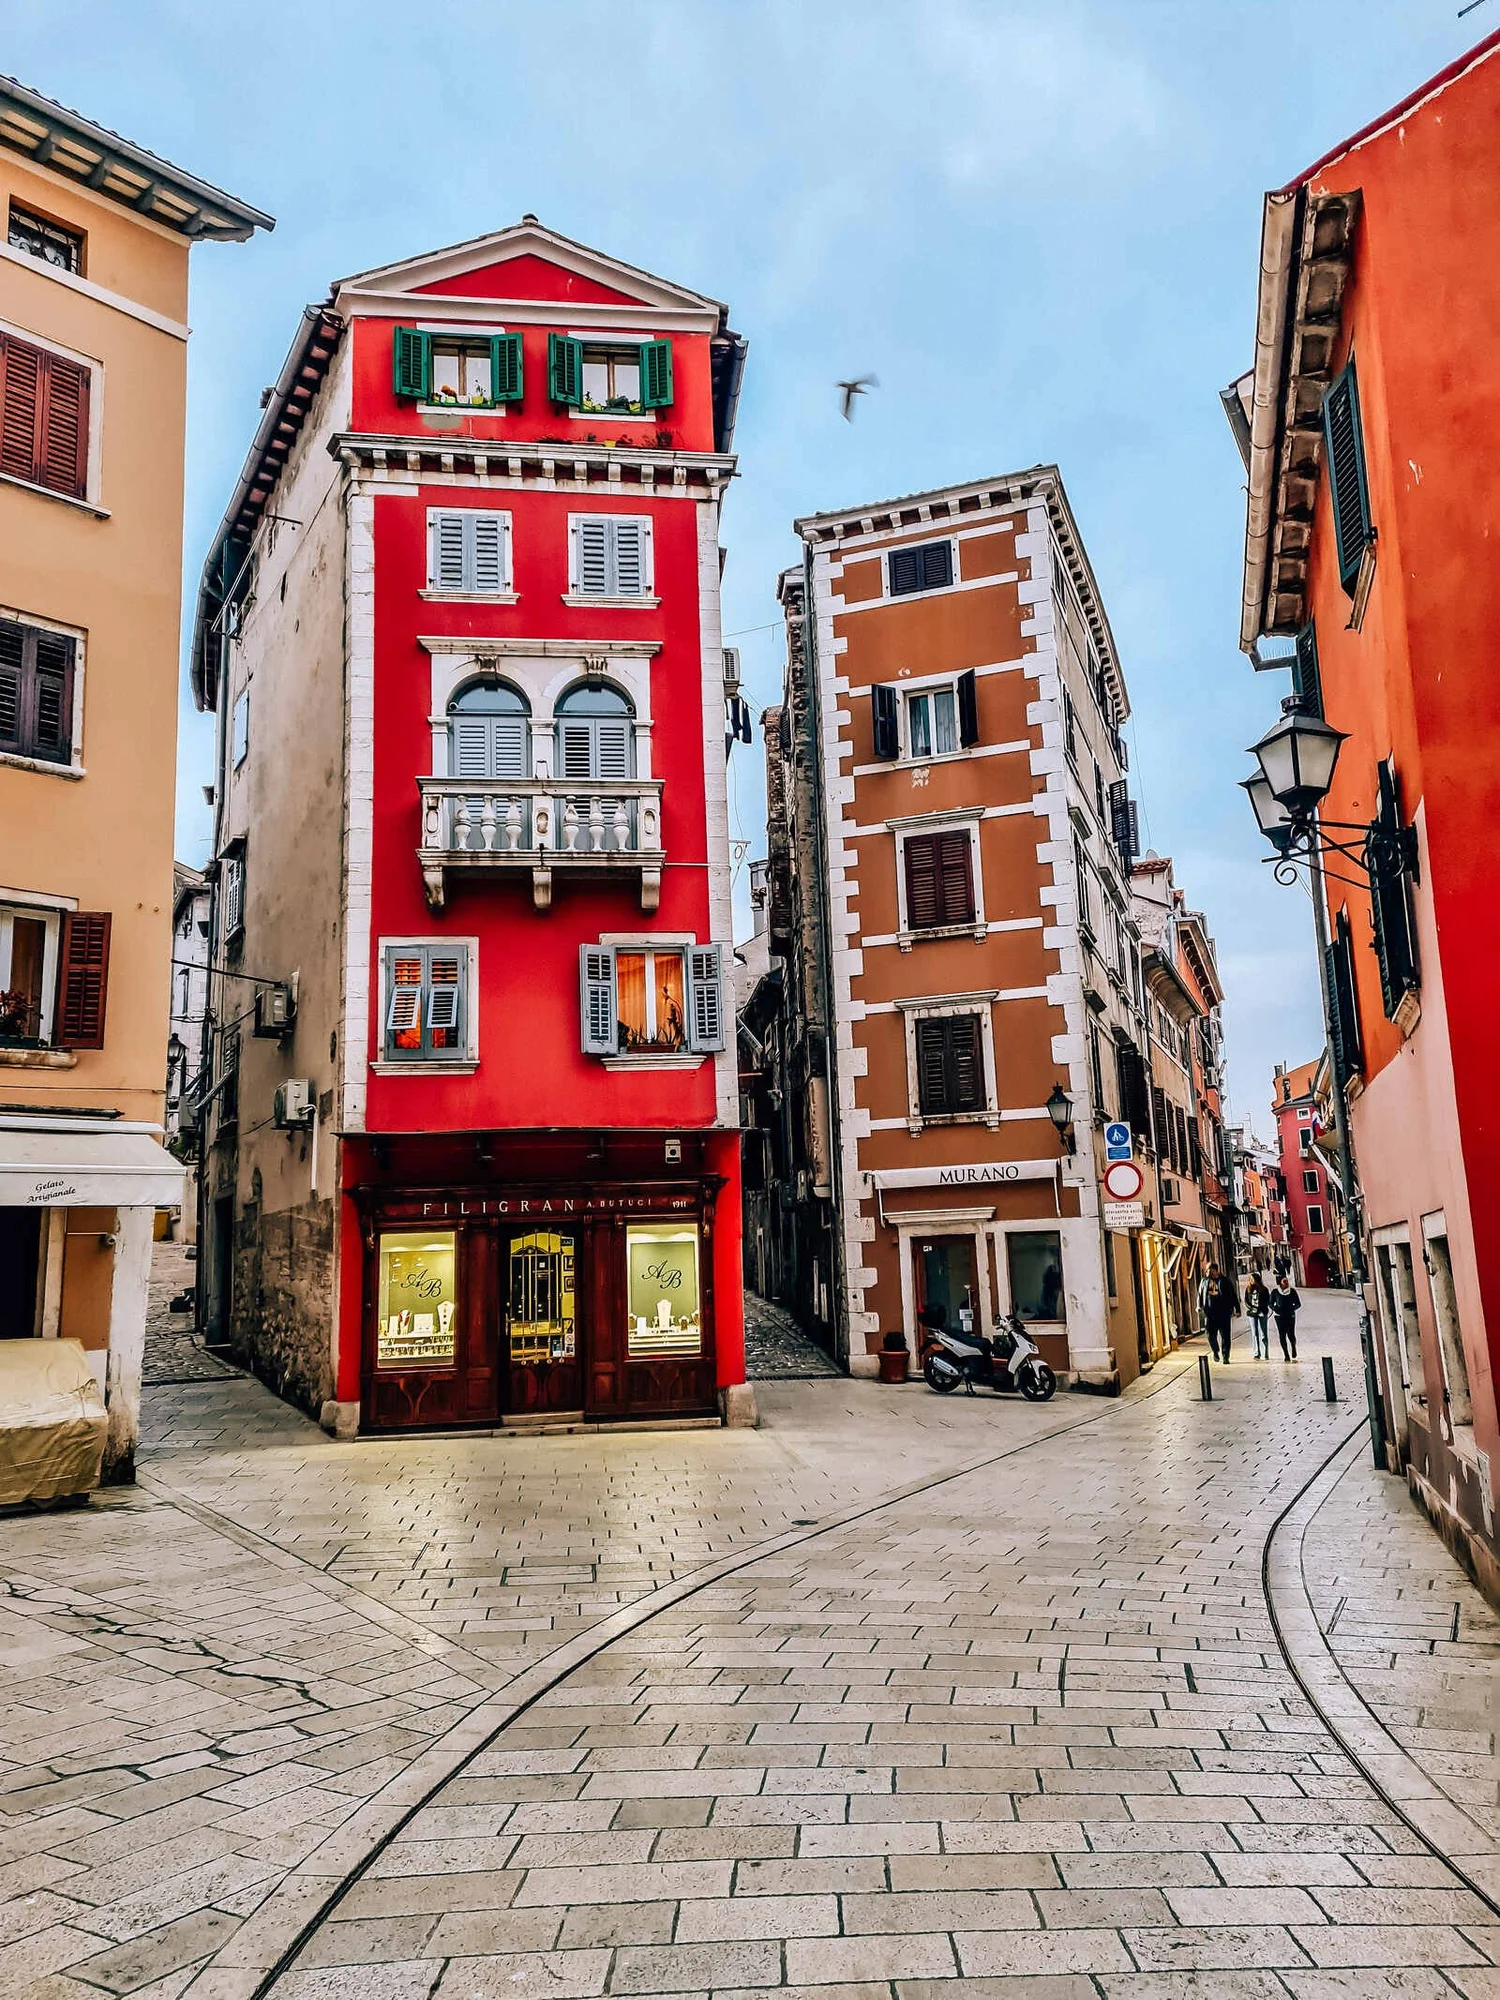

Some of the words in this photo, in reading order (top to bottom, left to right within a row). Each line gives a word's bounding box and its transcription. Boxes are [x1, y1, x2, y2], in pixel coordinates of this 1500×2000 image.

[939, 1165, 1019, 1184] MURANO
[35, 1179, 65, 1192] Gelato
[26, 1186, 76, 1204] Artigianale
[423, 1199, 574, 1215] FILIGRAN
